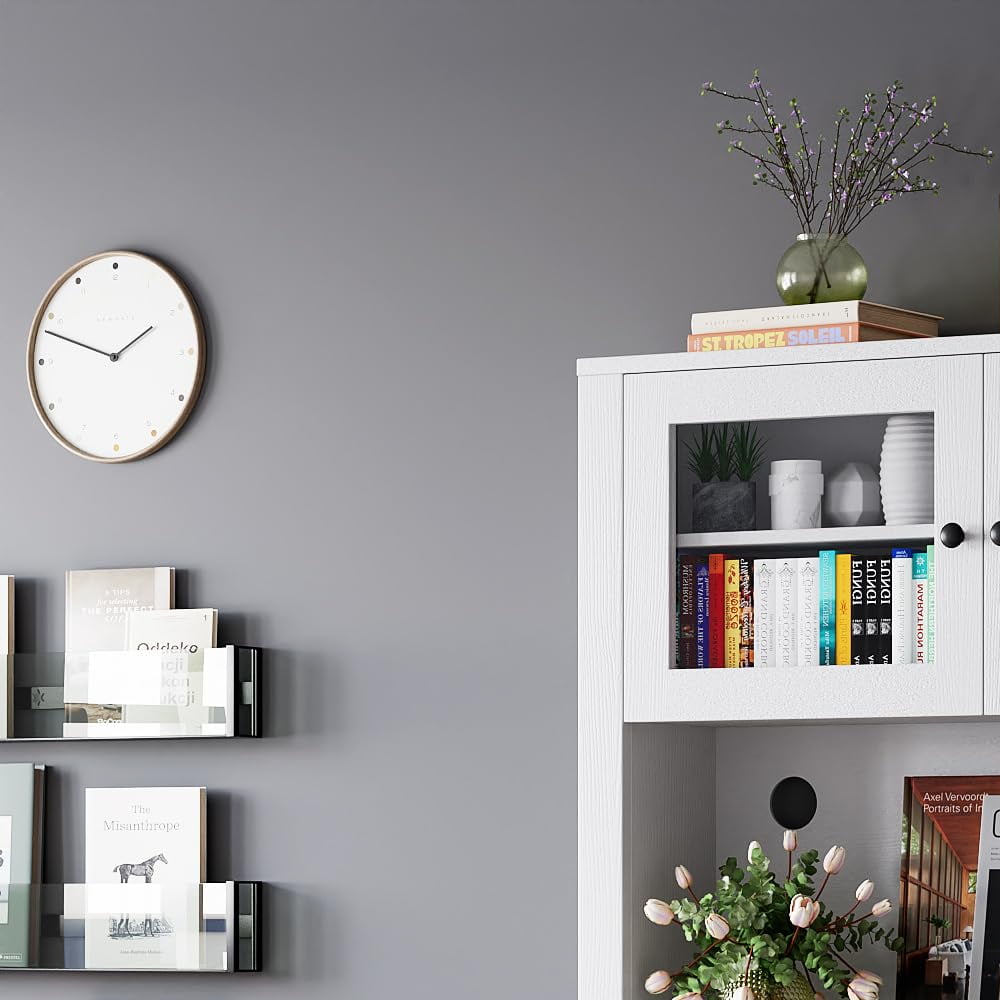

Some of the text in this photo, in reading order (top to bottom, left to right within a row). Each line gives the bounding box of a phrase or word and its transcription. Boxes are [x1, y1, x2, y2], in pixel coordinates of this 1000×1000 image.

[725, 331, 786, 351] TROPEZ
[923, 792, 943, 801] Axel
[131, 804, 151, 814] The
[923, 804, 960, 813] Portraits
[962, 804, 973, 813] of
[104, 820, 180, 832] Misanthrope
